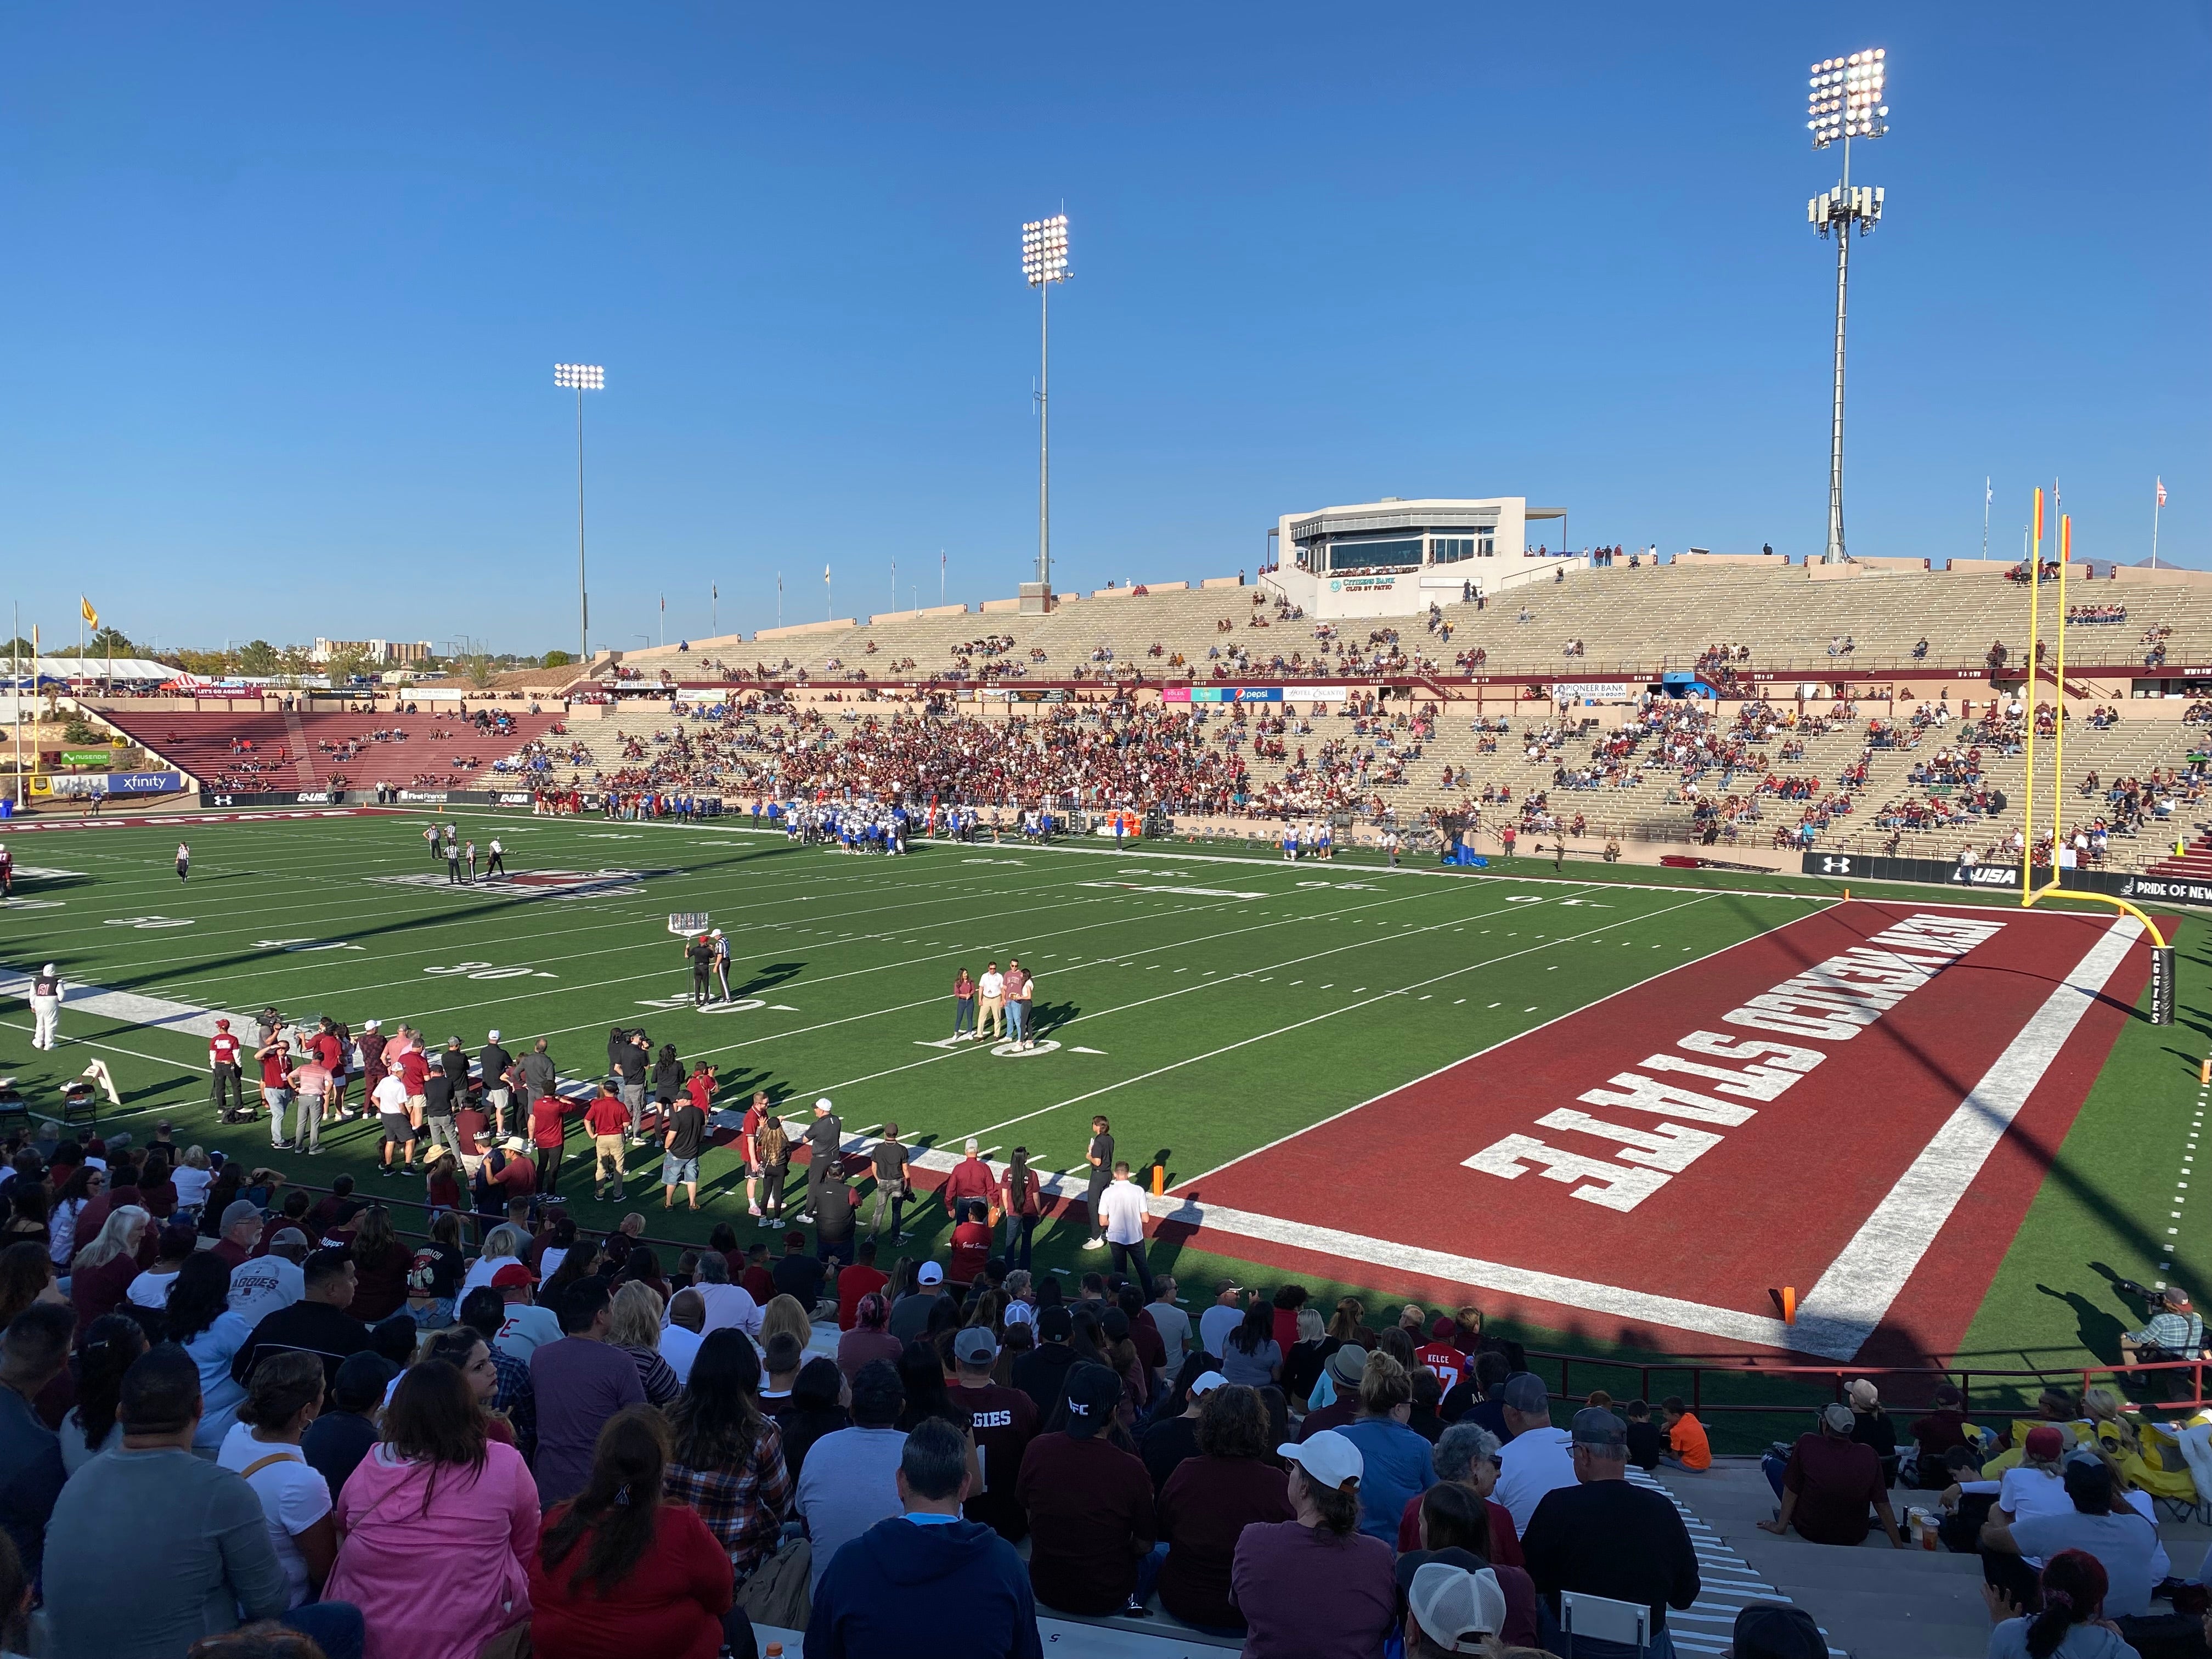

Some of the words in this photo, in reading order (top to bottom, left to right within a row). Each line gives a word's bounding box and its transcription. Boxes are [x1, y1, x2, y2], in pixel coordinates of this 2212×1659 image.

[1246, 690, 1268, 699] pepsi
[1287, 687, 1311, 697] HOTEL
[123, 775, 166, 791] xfinity
[2137, 882, 2169, 894] PRIDE
[2171, 885, 2186, 895] OF
[2190, 886, 2212, 899] NEW
[1866, 913, 2008, 954] NEW
[423, 962, 534, 979] 30
[37, 983, 49, 996] 61
[1722, 946, 1965, 1040] MEXICO
[2152, 950, 2161, 1024] AGGIES
[1460, 1030, 1827, 1213] STATE
[414, 1248, 432, 1258] LAMBDA
[432, 1249, 444, 1261] CHI
[232, 1278, 279, 1289] AGGIES
[1427, 1354, 1449, 1364] KELCE
